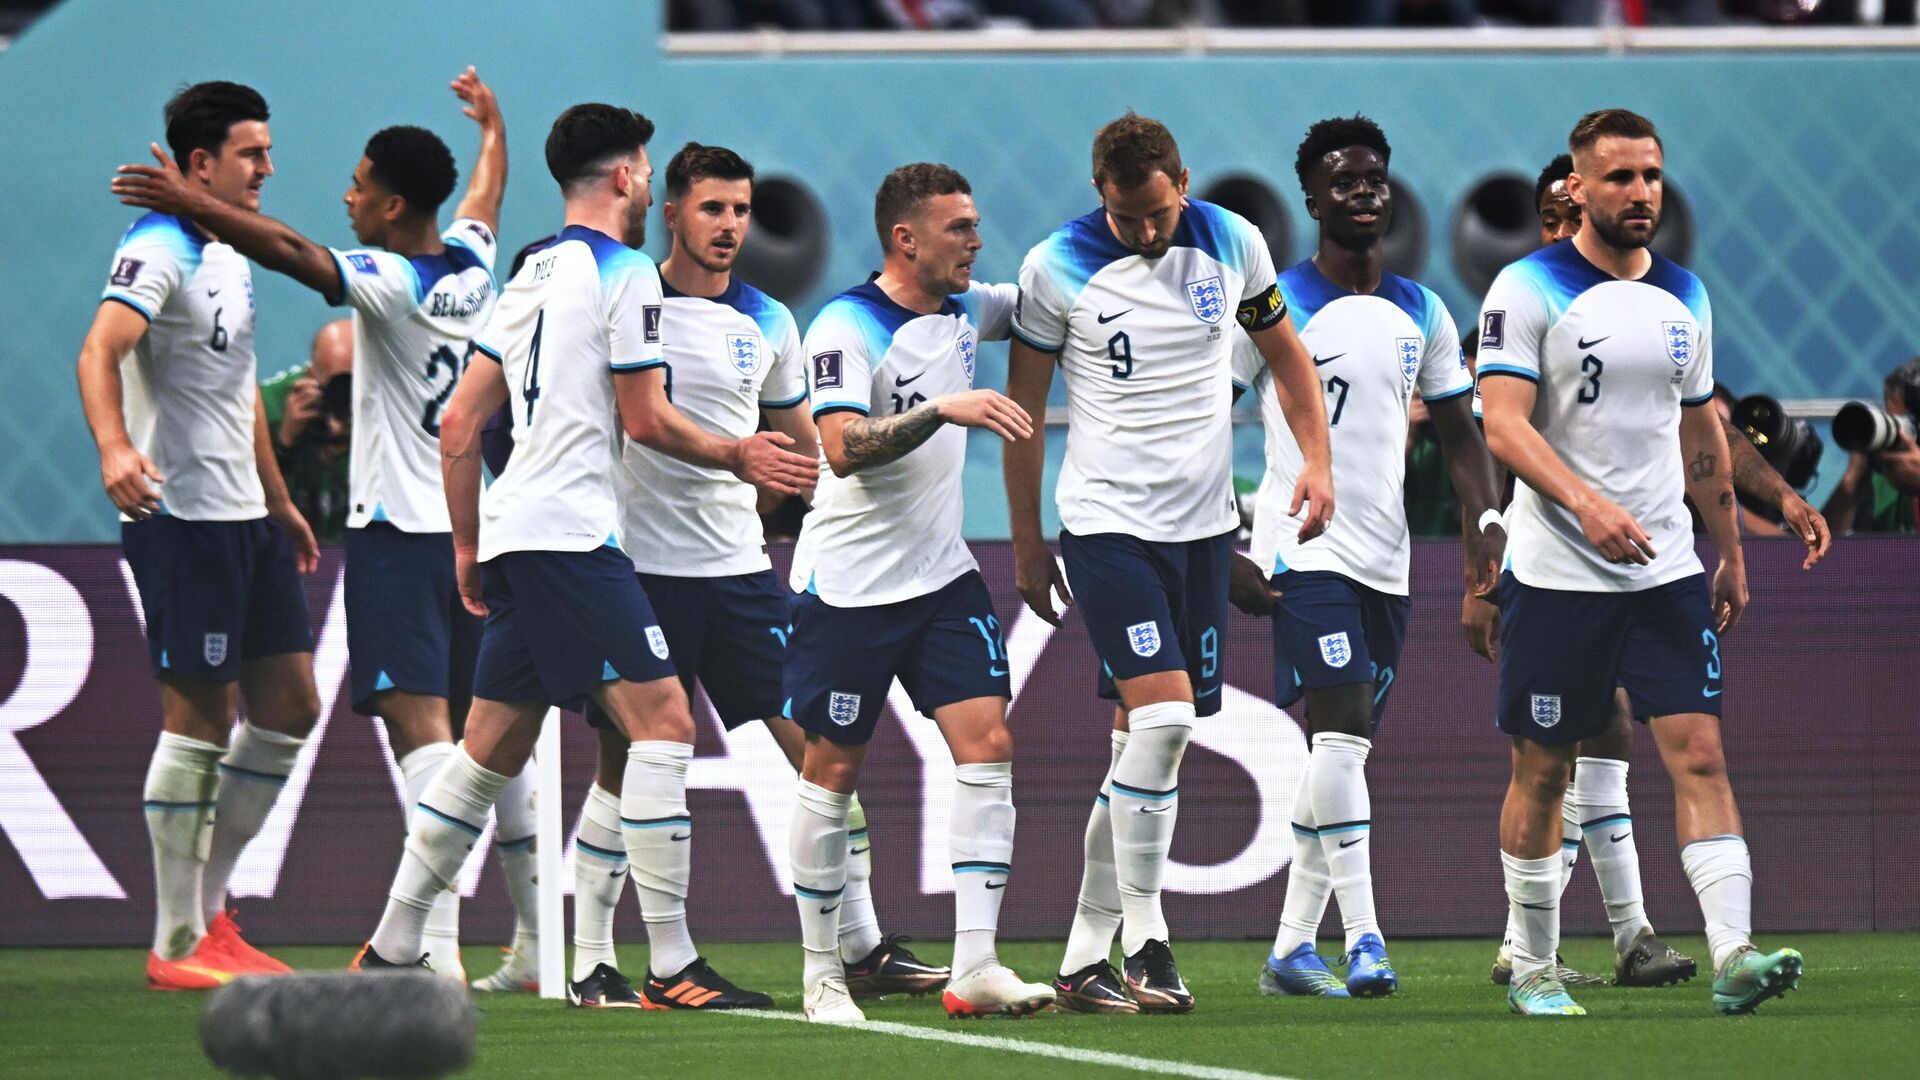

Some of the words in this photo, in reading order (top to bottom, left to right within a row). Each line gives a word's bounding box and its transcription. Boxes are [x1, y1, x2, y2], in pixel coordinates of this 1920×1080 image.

[211, 306, 227, 352] 6
[1108, 330, 1132, 379] 9
[421, 339, 482, 439] 2
[522, 308, 542, 427] 4
[1577, 353, 1603, 404] 3
[1200, 626, 1218, 678] 9
[1702, 628, 1721, 680] 3
